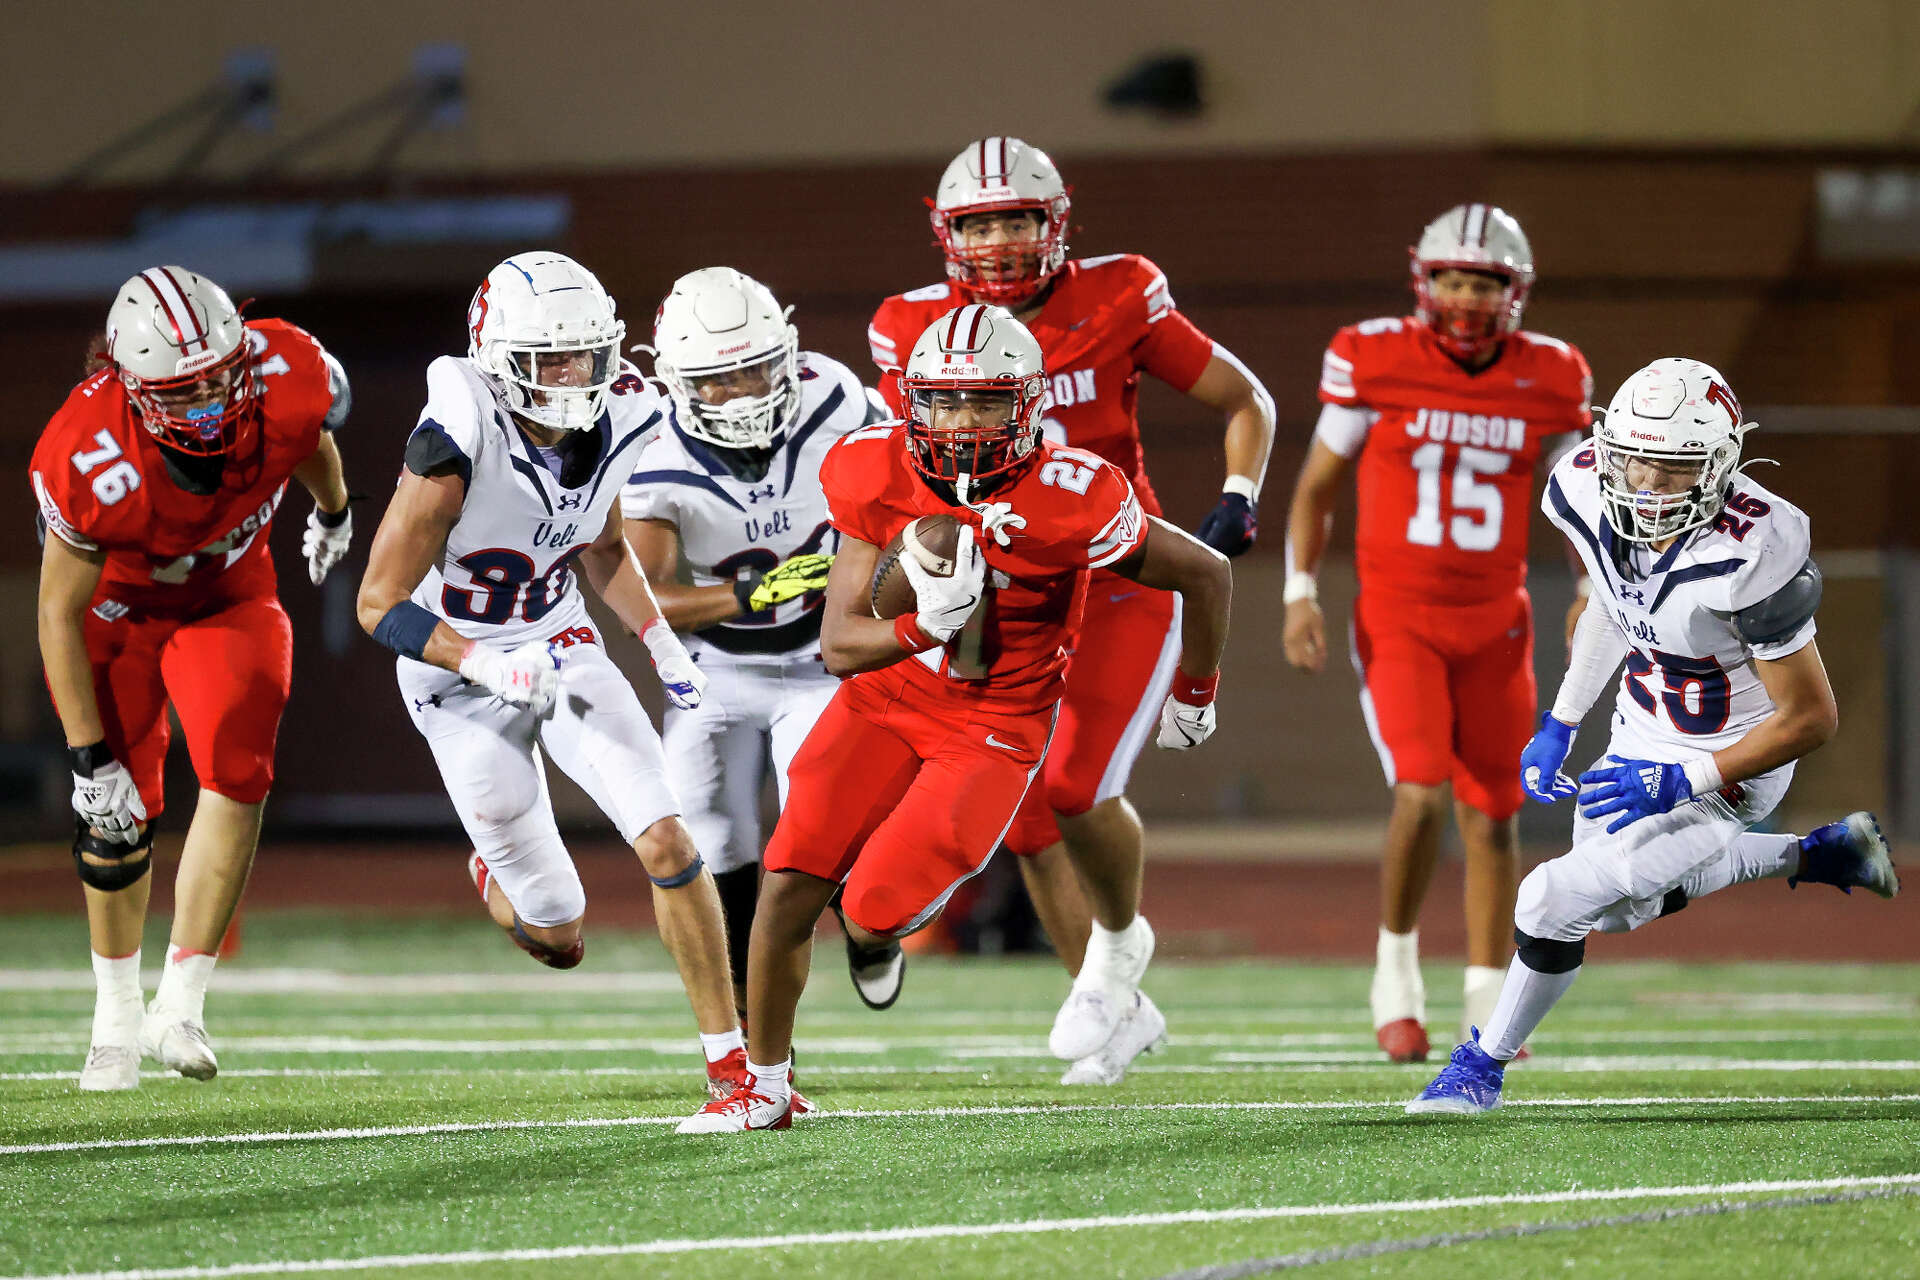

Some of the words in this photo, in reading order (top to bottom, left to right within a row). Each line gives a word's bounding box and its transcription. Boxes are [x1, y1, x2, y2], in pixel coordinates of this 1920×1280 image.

[1405, 408, 1526, 451] JUDSON
[1630, 429, 1665, 443] Riddell
[70, 427, 142, 506] 76
[1038, 450, 1105, 497] 21
[1407, 441, 1512, 552] 15
[1712, 491, 1771, 543] 25
[1624, 645, 1732, 736] 25
[1650, 763, 1664, 799] adidas
